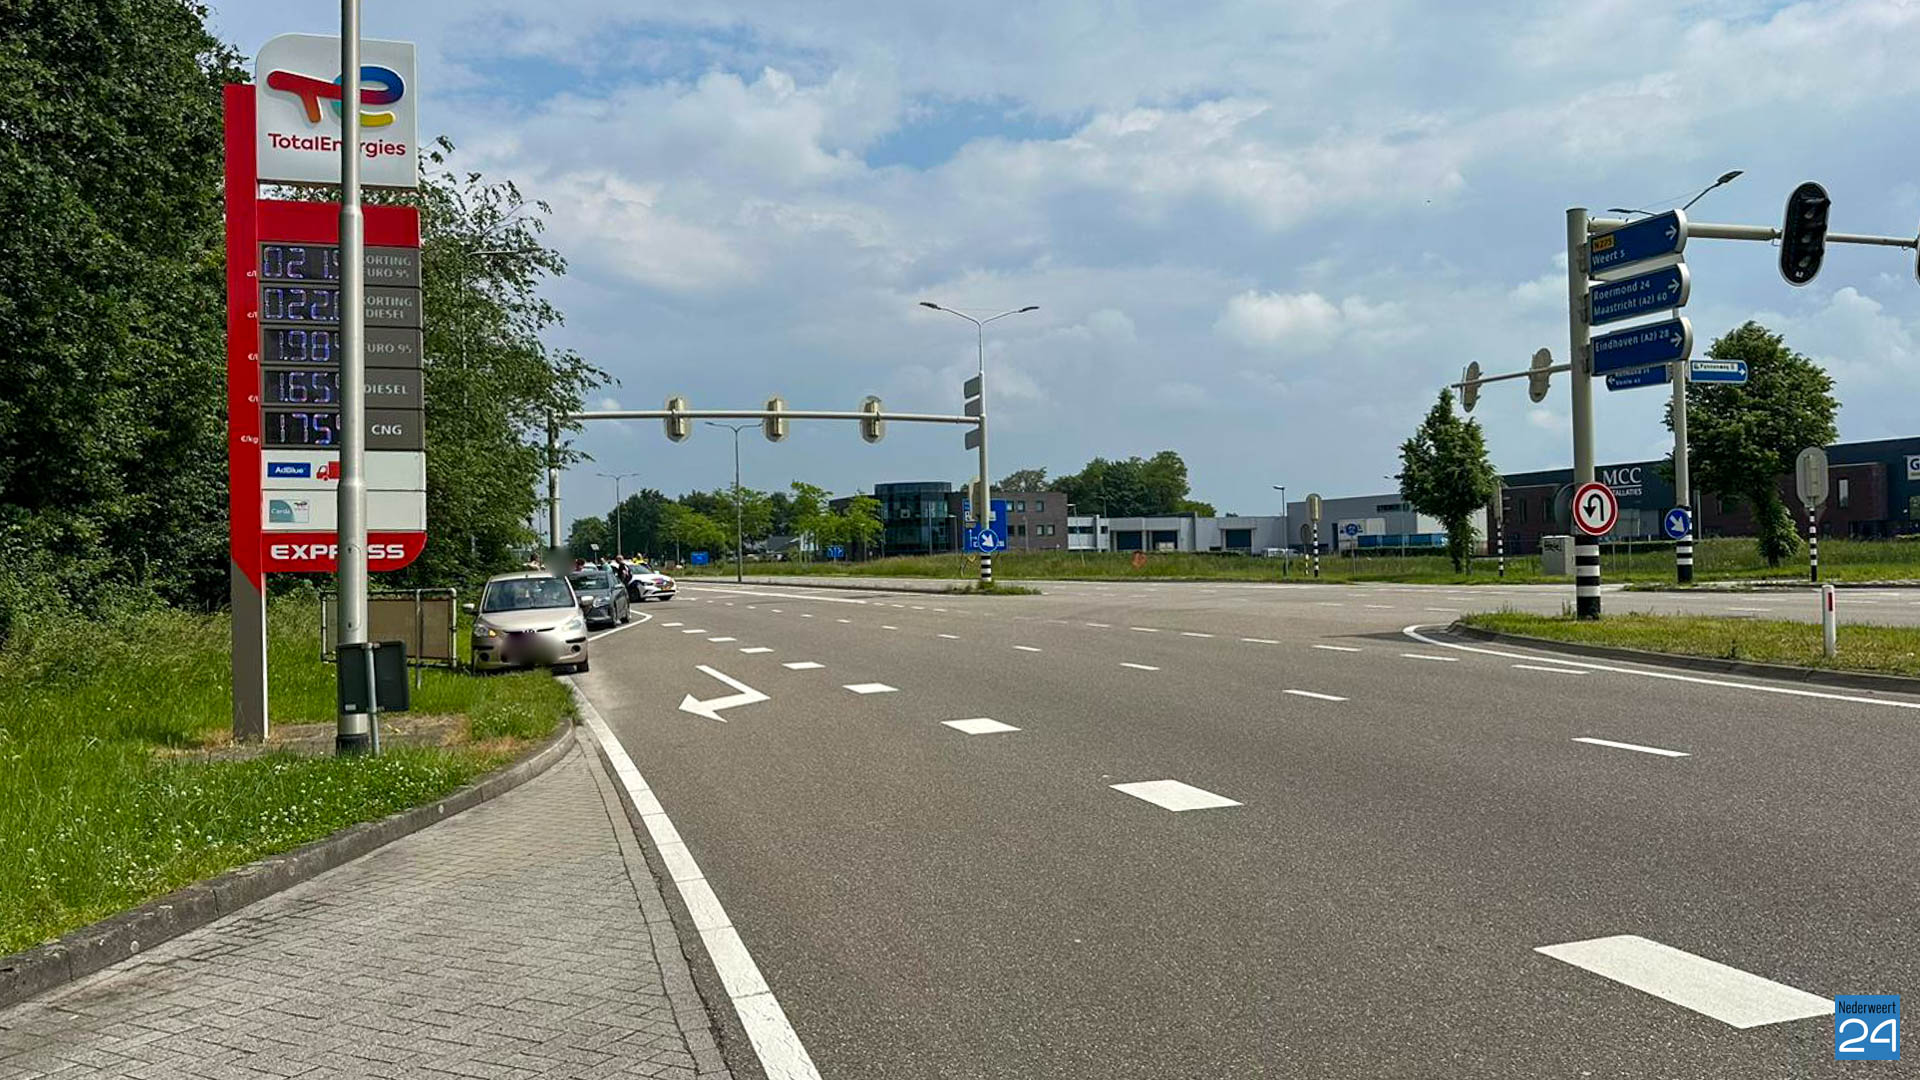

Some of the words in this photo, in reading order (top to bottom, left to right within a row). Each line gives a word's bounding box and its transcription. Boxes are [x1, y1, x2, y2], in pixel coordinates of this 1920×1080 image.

[268, 132, 406, 158] TotalEnrgies
[364, 254, 412, 267] ORTING
[1592, 251, 1618, 266] Weert
[1620, 249, 1626, 259] 5
[367, 267, 393, 278] URO
[1594, 281, 1638, 300] Roermond
[1640, 280, 1650, 291] 24
[364, 296, 413, 308] ORTING
[1594, 298, 1637, 316] Maastricht
[1639, 294, 1655, 307] (A2)
[1657, 292, 1668, 302] 60
[365, 308, 404, 320] DIESEL
[1595, 335, 1639, 353] Eindhoven
[1640, 330, 1657, 343] (A2)
[367, 343, 394, 354] URO
[397, 344, 413, 355] 95
[364, 383, 408, 395] DIESEL
[371, 424, 402, 436] CNG
[274, 466, 305, 474] AdBlue
[1603, 467, 1642, 485] MCC
[1612, 488, 1642, 497] TALLATIES
[270, 544, 405, 560] EXPSS
